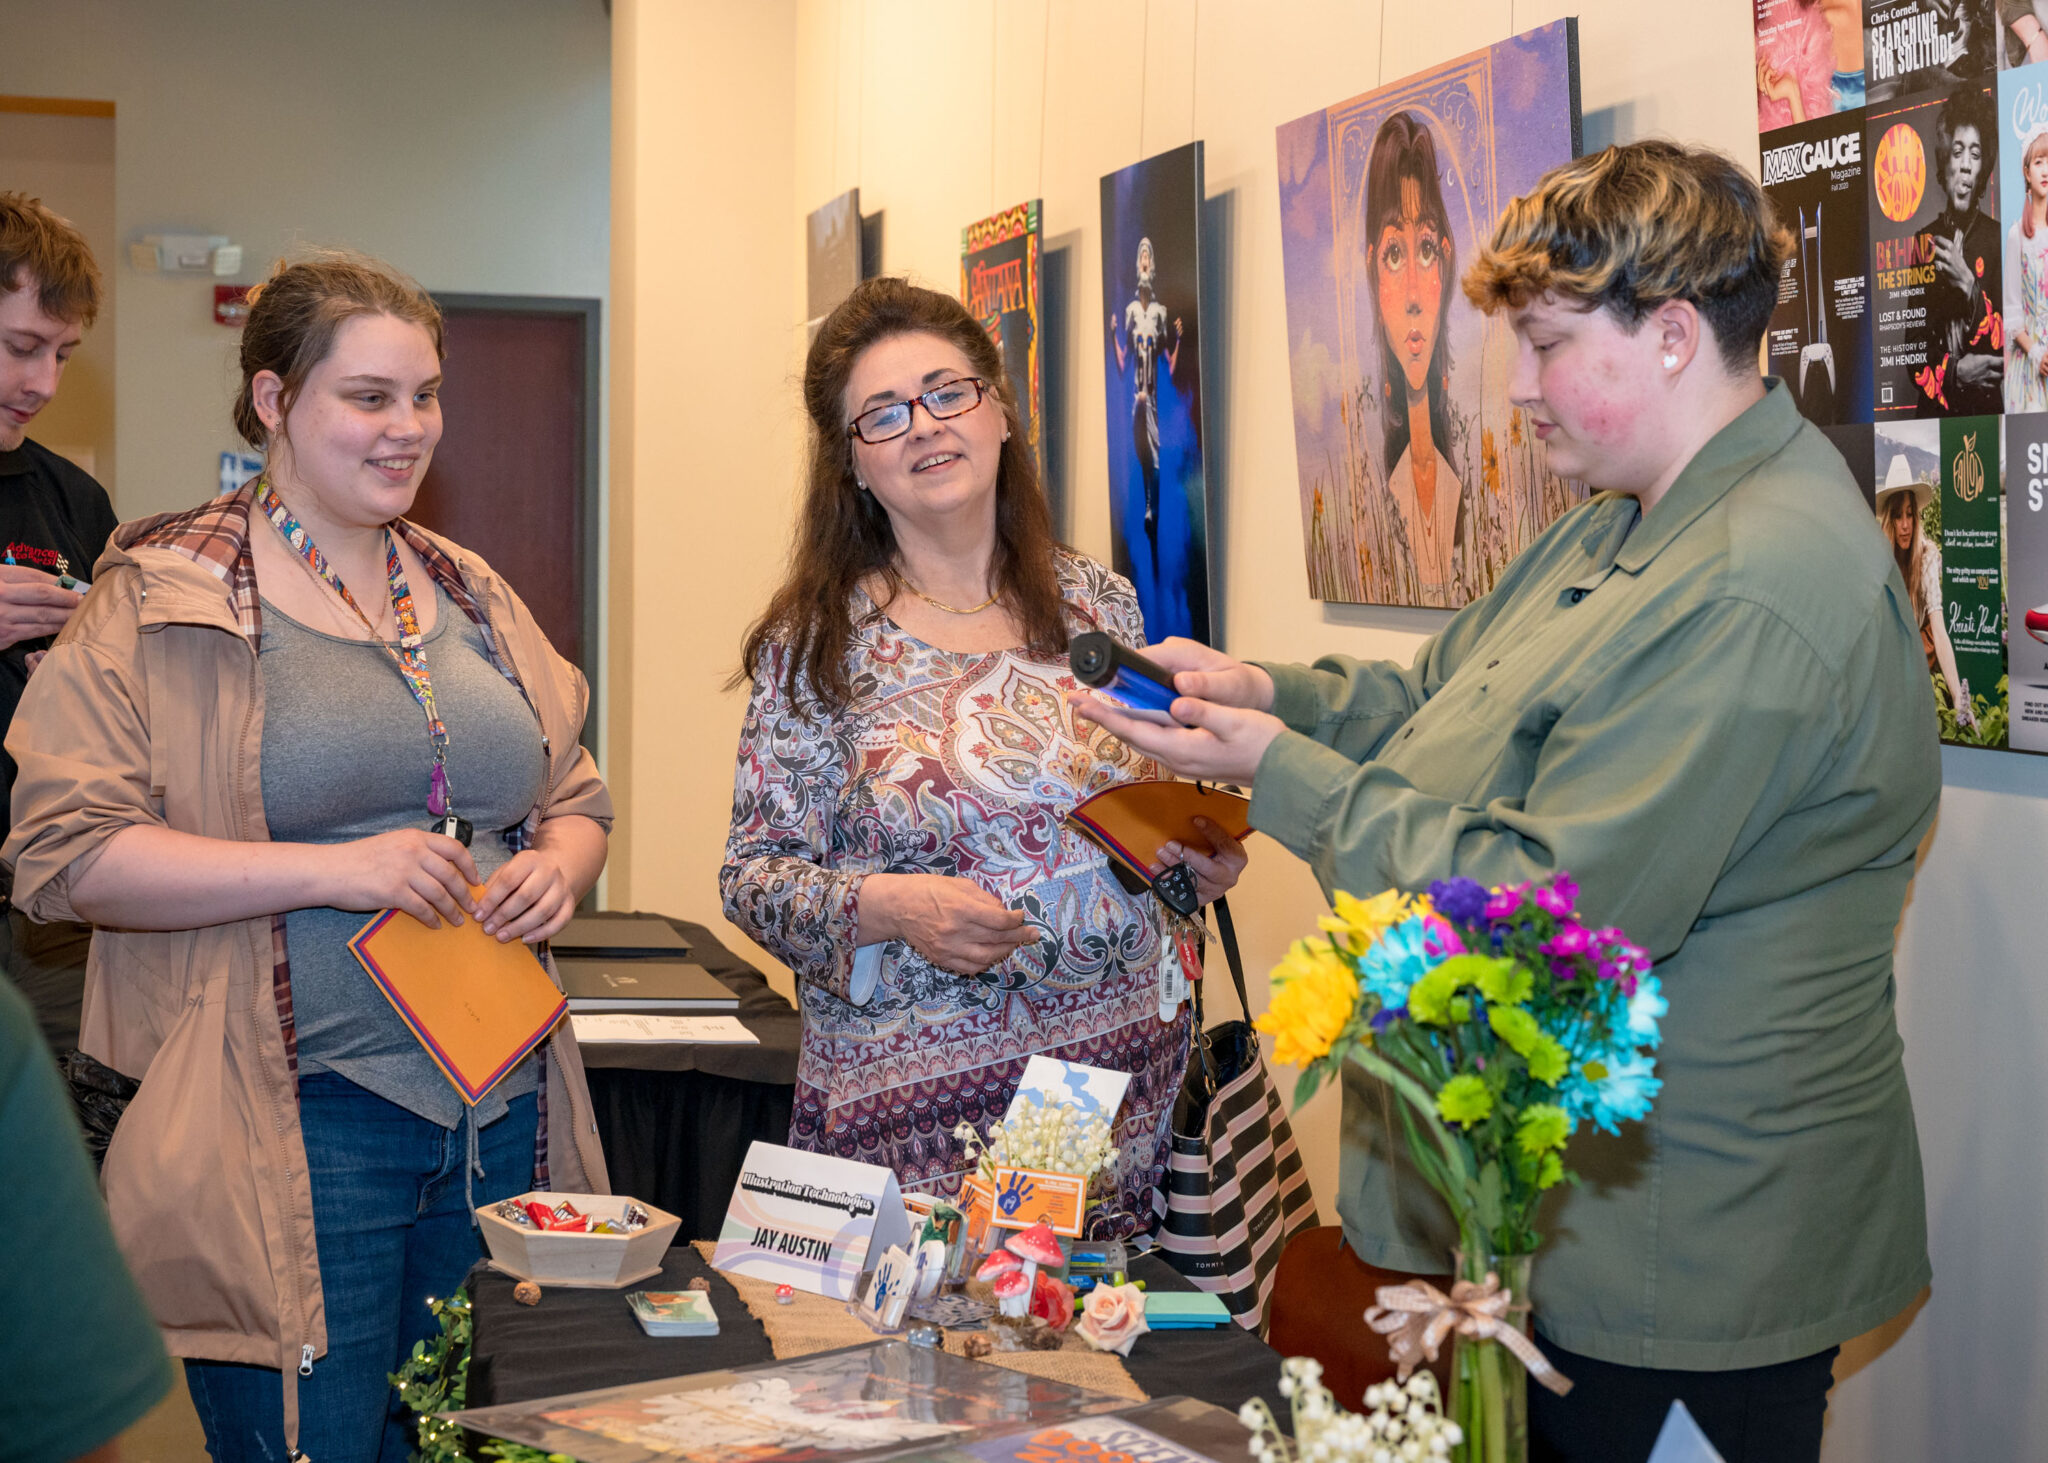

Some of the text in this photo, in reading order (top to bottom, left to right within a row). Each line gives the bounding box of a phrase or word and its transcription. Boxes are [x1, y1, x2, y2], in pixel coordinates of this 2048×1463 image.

[1871, 1, 1919, 25] Chris Cornell,
[1872, 10, 1939, 50] SEARCHING
[1872, 32, 1955, 81] FOR SOLITUDE
[1831, 166, 1861, 181] Magazine
[1876, 233, 1936, 271] BEHIND
[1877, 265, 1936, 290] THE STRINGS
[1889, 288, 1925, 299] JIMI HENDRIX
[1879, 307, 1926, 322] LOST & FOUND
[1906, 320, 1926, 328] REVIEWS
[1880, 342, 1927, 354] THE HISTORY OF
[1880, 353, 1927, 367] JIMI HENDRIX
[7, 541, 56, 558] Advance
[742, 1172, 875, 1218] Illustration Technologies
[750, 1227, 833, 1262] JAY AUSTIN
[1195, 1261, 1219, 1269] TOMMY
